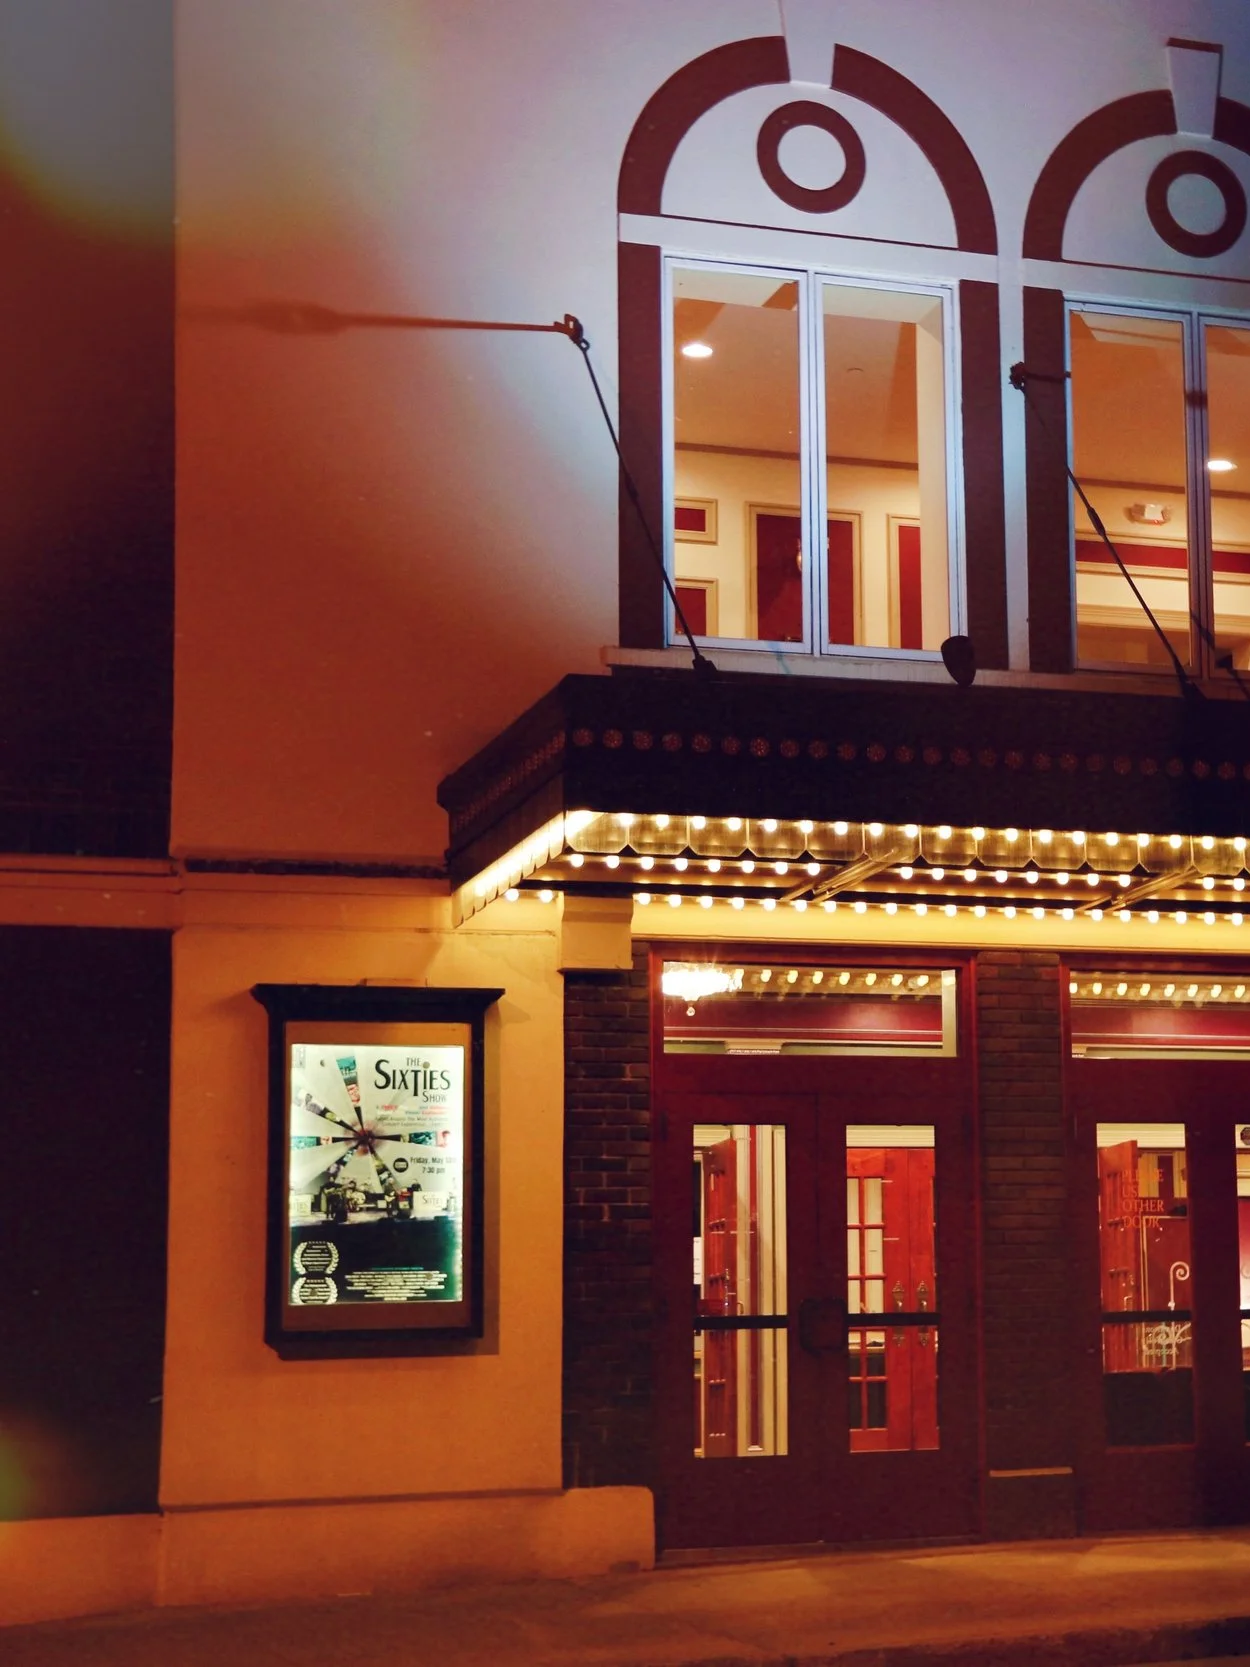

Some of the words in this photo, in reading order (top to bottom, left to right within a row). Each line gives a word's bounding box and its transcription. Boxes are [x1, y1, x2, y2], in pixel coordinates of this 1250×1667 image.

[406, 1057, 422, 1067] THE
[374, 1059, 451, 1097] SIXTIES
[422, 1091, 448, 1103] SHOW
[431, 1156, 444, 1165] May
[1122, 1169, 1164, 1183] PLEE
[1122, 1199, 1165, 1212] OTHER
